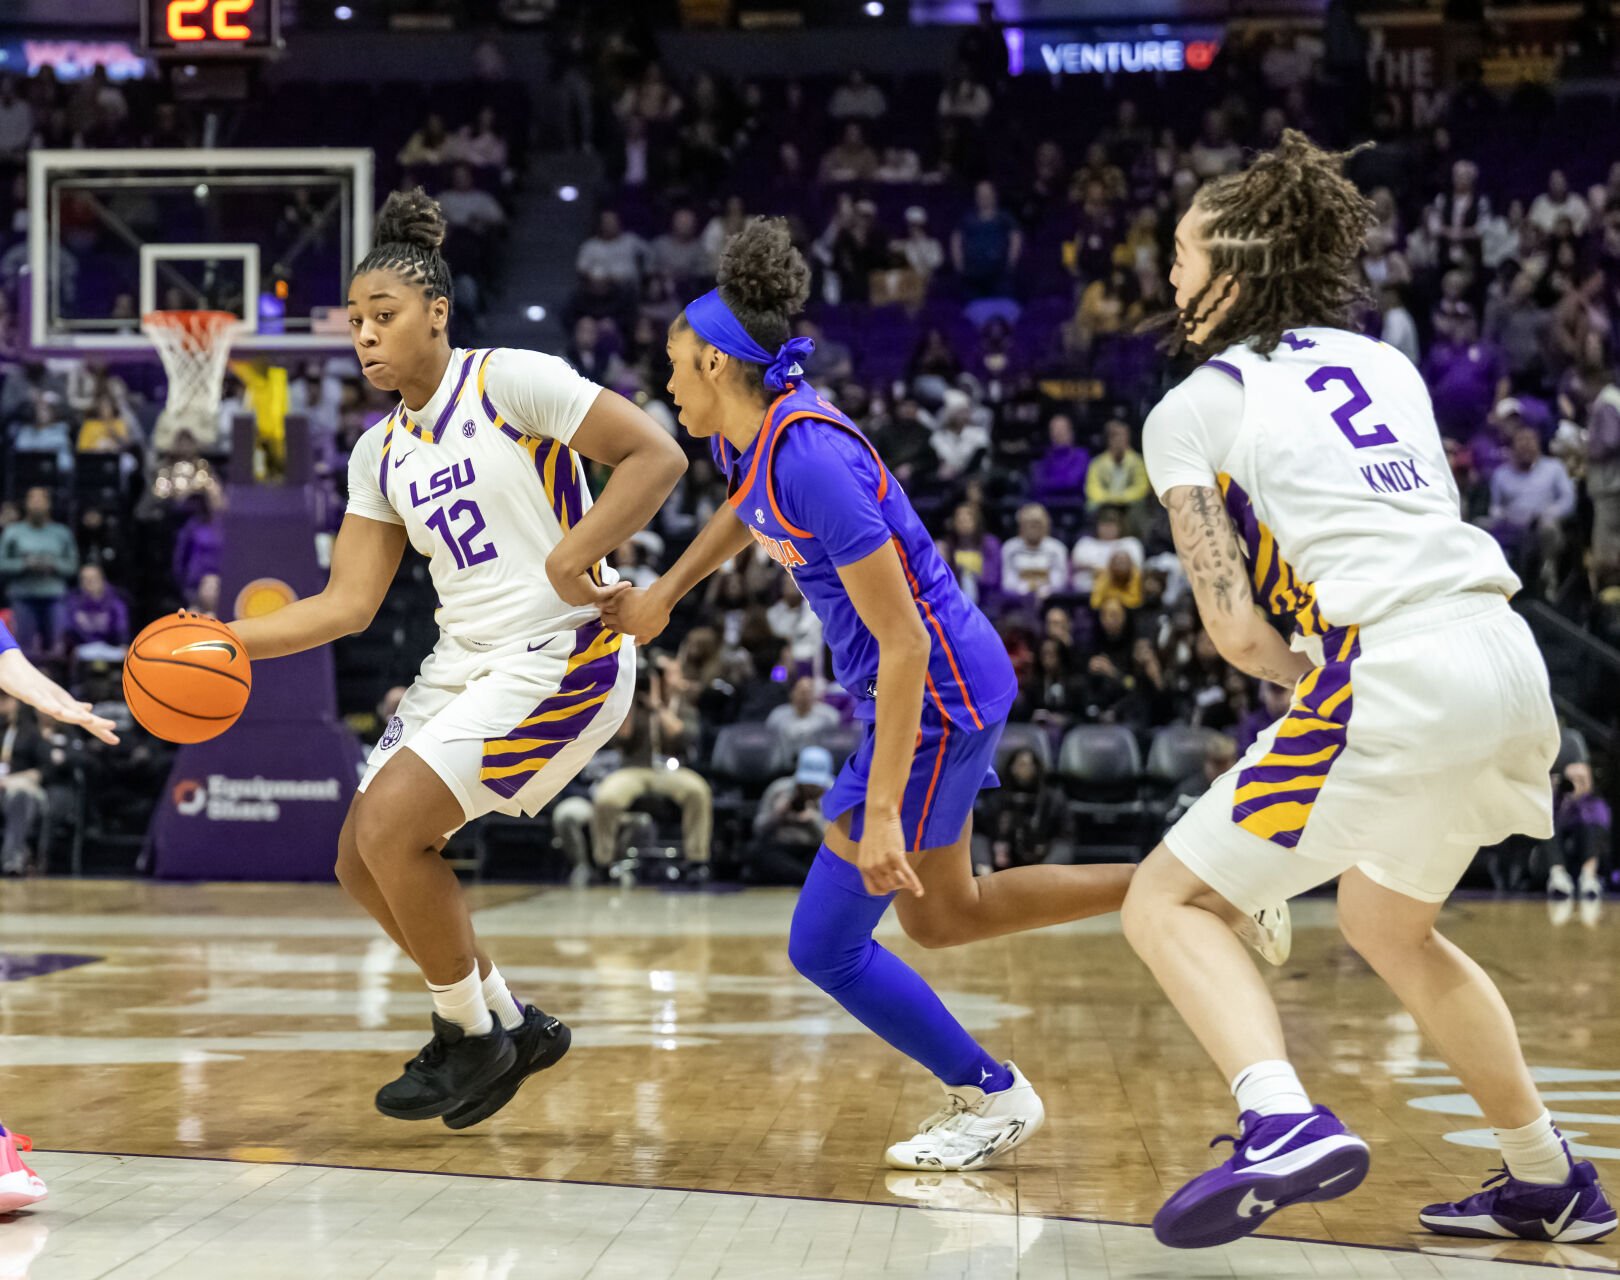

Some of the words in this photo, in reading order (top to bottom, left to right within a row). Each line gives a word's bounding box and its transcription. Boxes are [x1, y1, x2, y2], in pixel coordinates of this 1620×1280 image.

[167, 0, 252, 40] 22
[1040, 40, 1184, 74] VENTURE
[1305, 366, 1399, 449] 2
[409, 457, 476, 508] LSU
[1360, 459, 1429, 493] KNOX
[425, 499, 498, 570] 12
